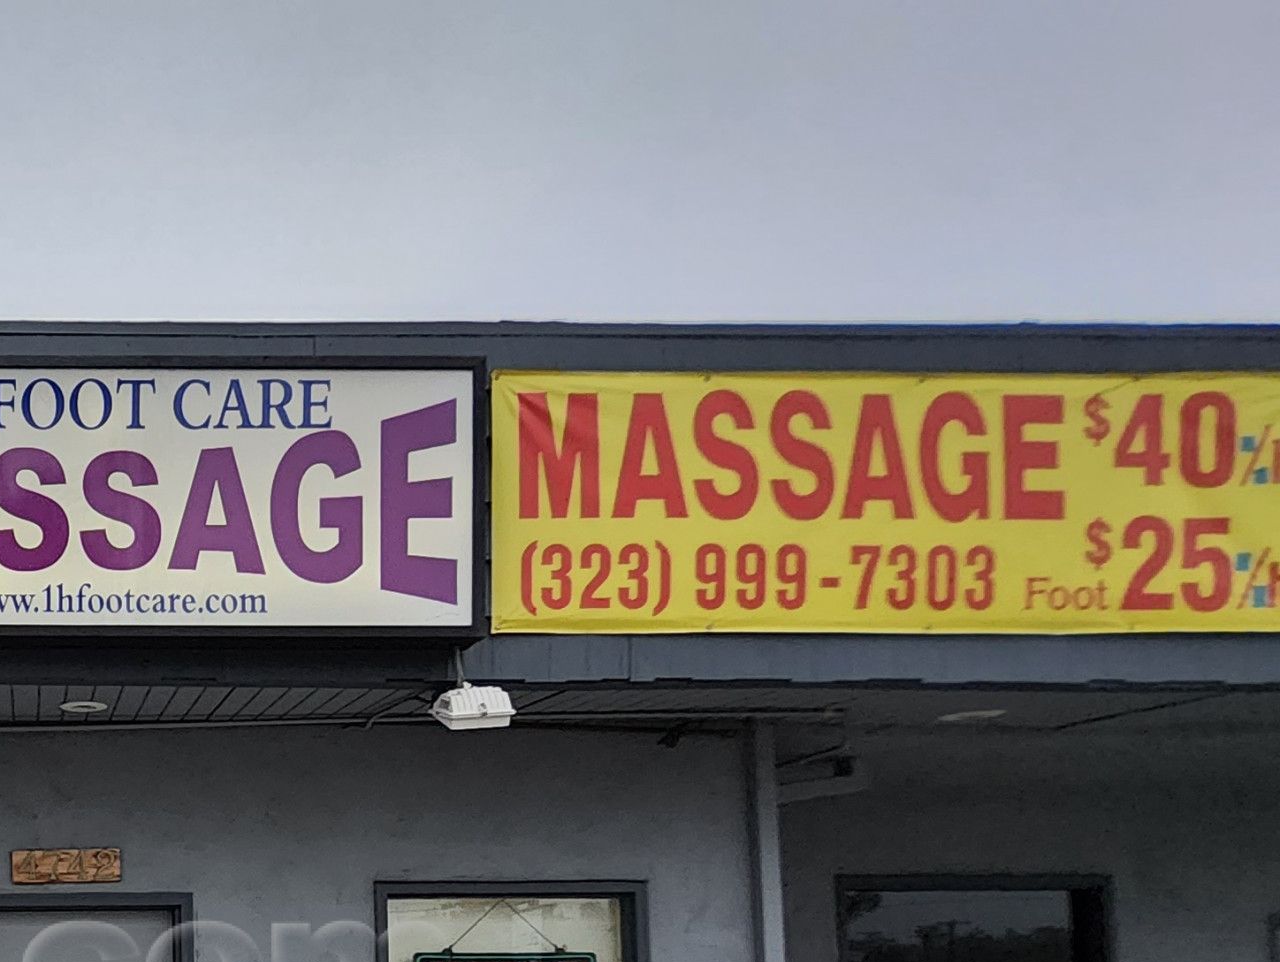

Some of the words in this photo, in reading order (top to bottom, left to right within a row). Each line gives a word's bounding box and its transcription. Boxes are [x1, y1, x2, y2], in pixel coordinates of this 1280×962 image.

[172, 378, 333, 431] CARE
[516, 388, 1066, 524] MASSAGE
[520, 540, 672, 617] (323)
[695, 542, 996, 612] 999-7303
[1022, 576, 1109, 611] Foot
[16, 850, 118, 881] 4742
